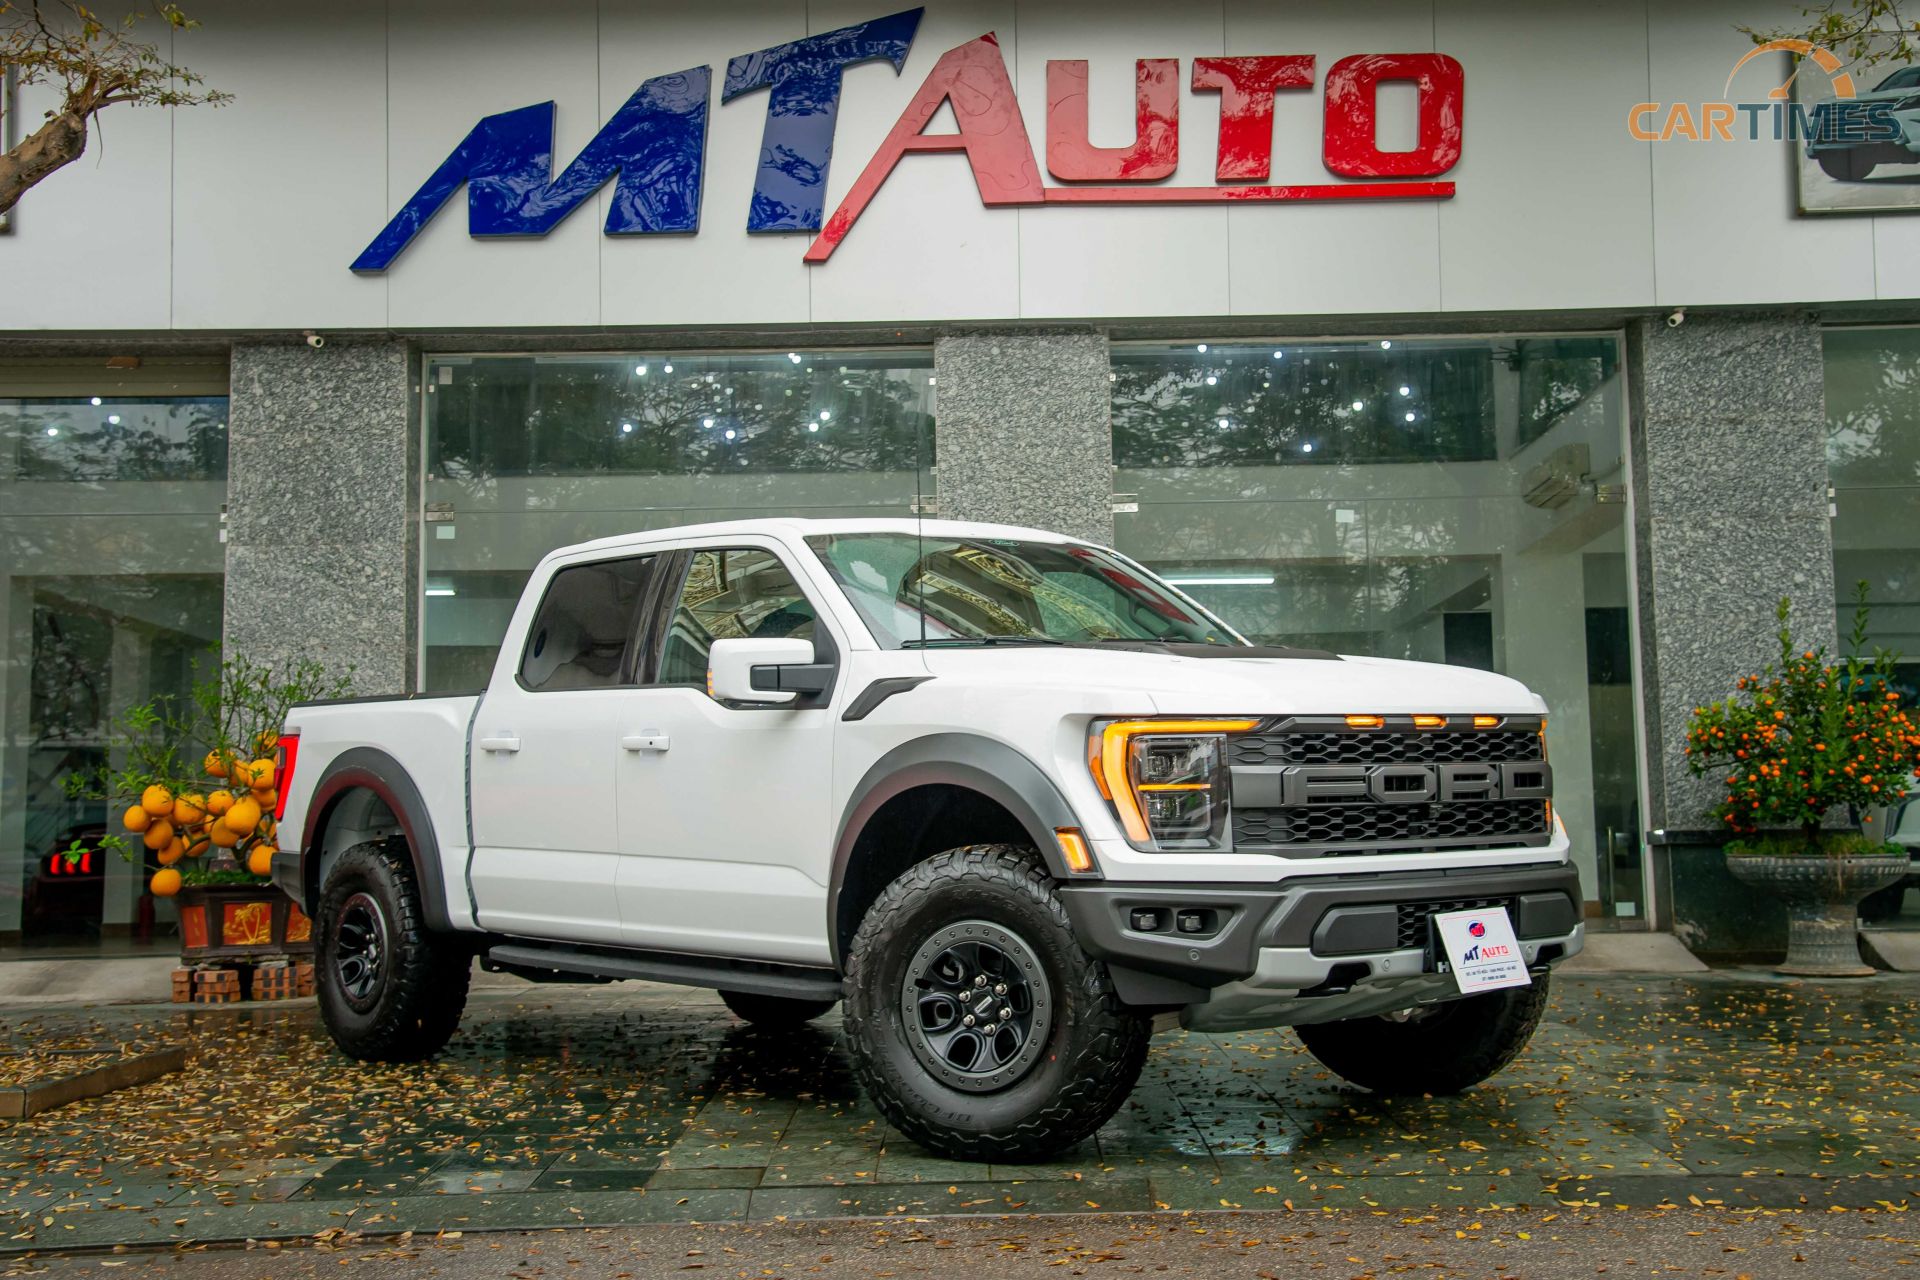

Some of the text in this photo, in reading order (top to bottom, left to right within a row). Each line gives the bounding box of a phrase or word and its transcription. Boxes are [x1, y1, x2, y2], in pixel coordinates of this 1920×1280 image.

[1281, 762, 1553, 806] FORD
[1463, 944, 1511, 965] MT AUTO
